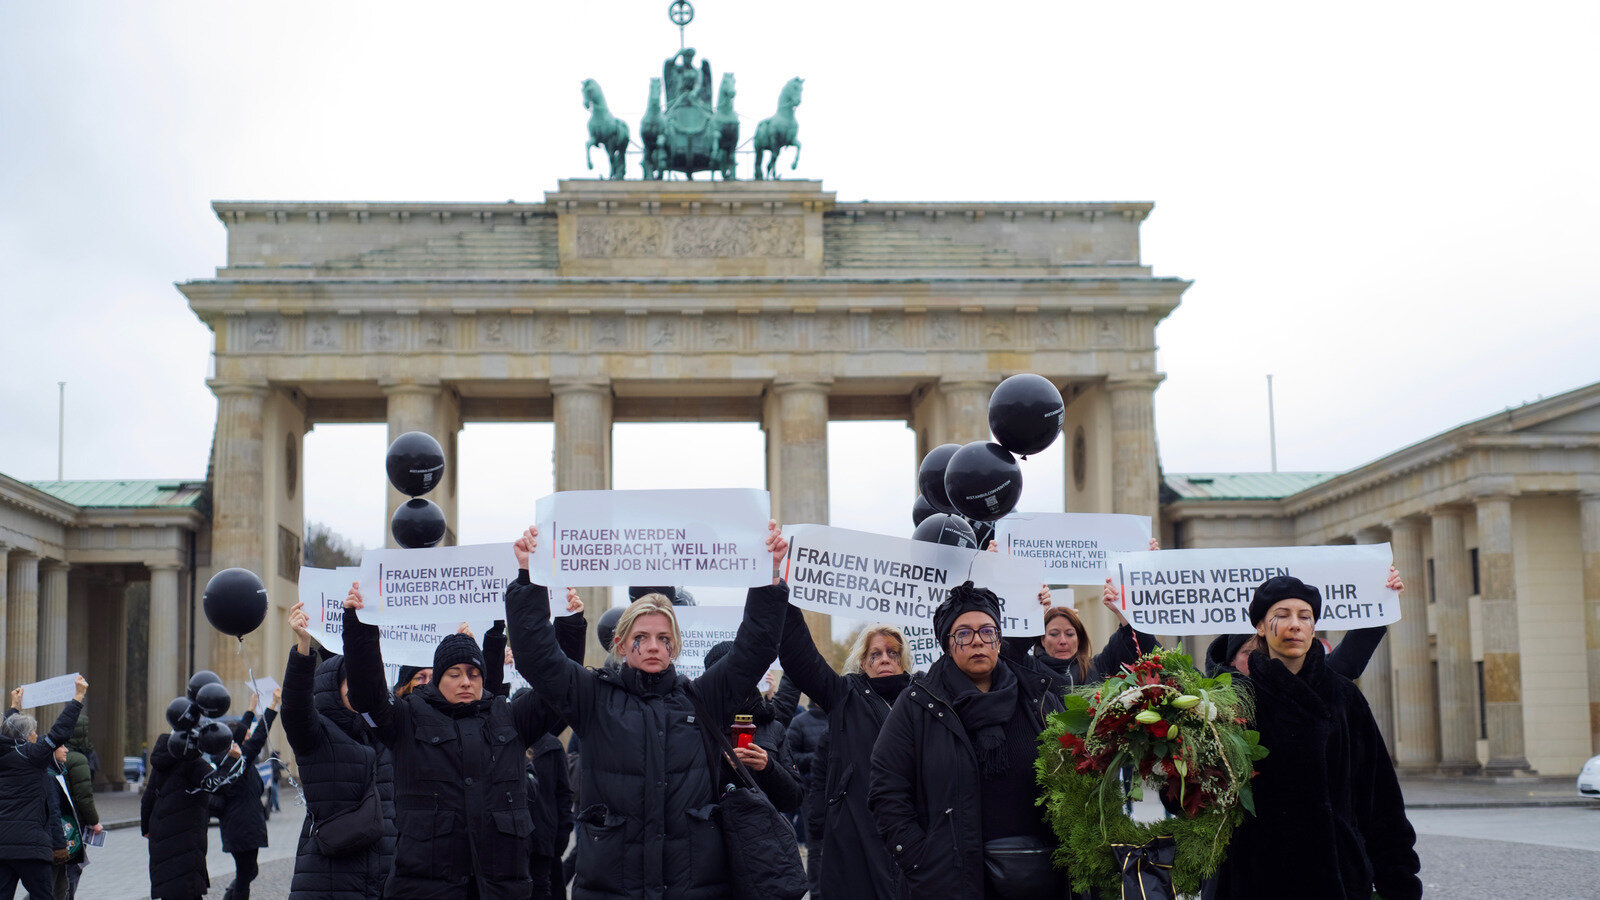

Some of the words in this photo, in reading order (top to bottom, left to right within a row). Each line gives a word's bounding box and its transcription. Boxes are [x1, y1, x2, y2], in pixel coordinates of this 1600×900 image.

[560, 529, 620, 541] FRAUEN
[624, 528, 686, 540] WERDEN
[560, 543, 668, 557] UMGEBRACHT,
[671, 543, 708, 555] WEIL
[712, 543, 737, 555] IHR
[1013, 539, 1053, 548] FRAUEN
[1056, 540, 1098, 549] WERDEN
[1088, 550, 1107, 559] WEI
[560, 559, 610, 571] EUREN
[613, 559, 642, 571] JOB
[646, 559, 692, 570] NICHT
[696, 558, 749, 570] MACHT
[796, 547, 869, 572] FRAUEN
[873, 559, 948, 585] WERDEN
[1049, 560, 1068, 568] JOB
[1071, 560, 1101, 569] NICHT
[386, 568, 437, 580] FRAUEN
[440, 566, 494, 578] WERDEN
[1130, 569, 1205, 586] FRAUEN
[386, 580, 478, 594] UMGEBRACHT,
[794, 567, 922, 603] UMGEBRACHT,
[927, 586, 951, 603] WE
[1325, 584, 1357, 600] IHR
[387, 595, 429, 607] EUREN
[432, 594, 456, 605] JOB
[459, 592, 499, 604] NICHT
[793, 586, 852, 606] EUREN
[856, 596, 891, 613] JOB
[895, 600, 937, 619] NICH
[1132, 608, 1196, 624] EUREN
[1200, 607, 1237, 623] JOB
[1320, 603, 1373, 619] ACHT
[380, 629, 408, 640] NICHT
[680, 630, 703, 638] AUEN
[705, 630, 736, 639] WERDE
